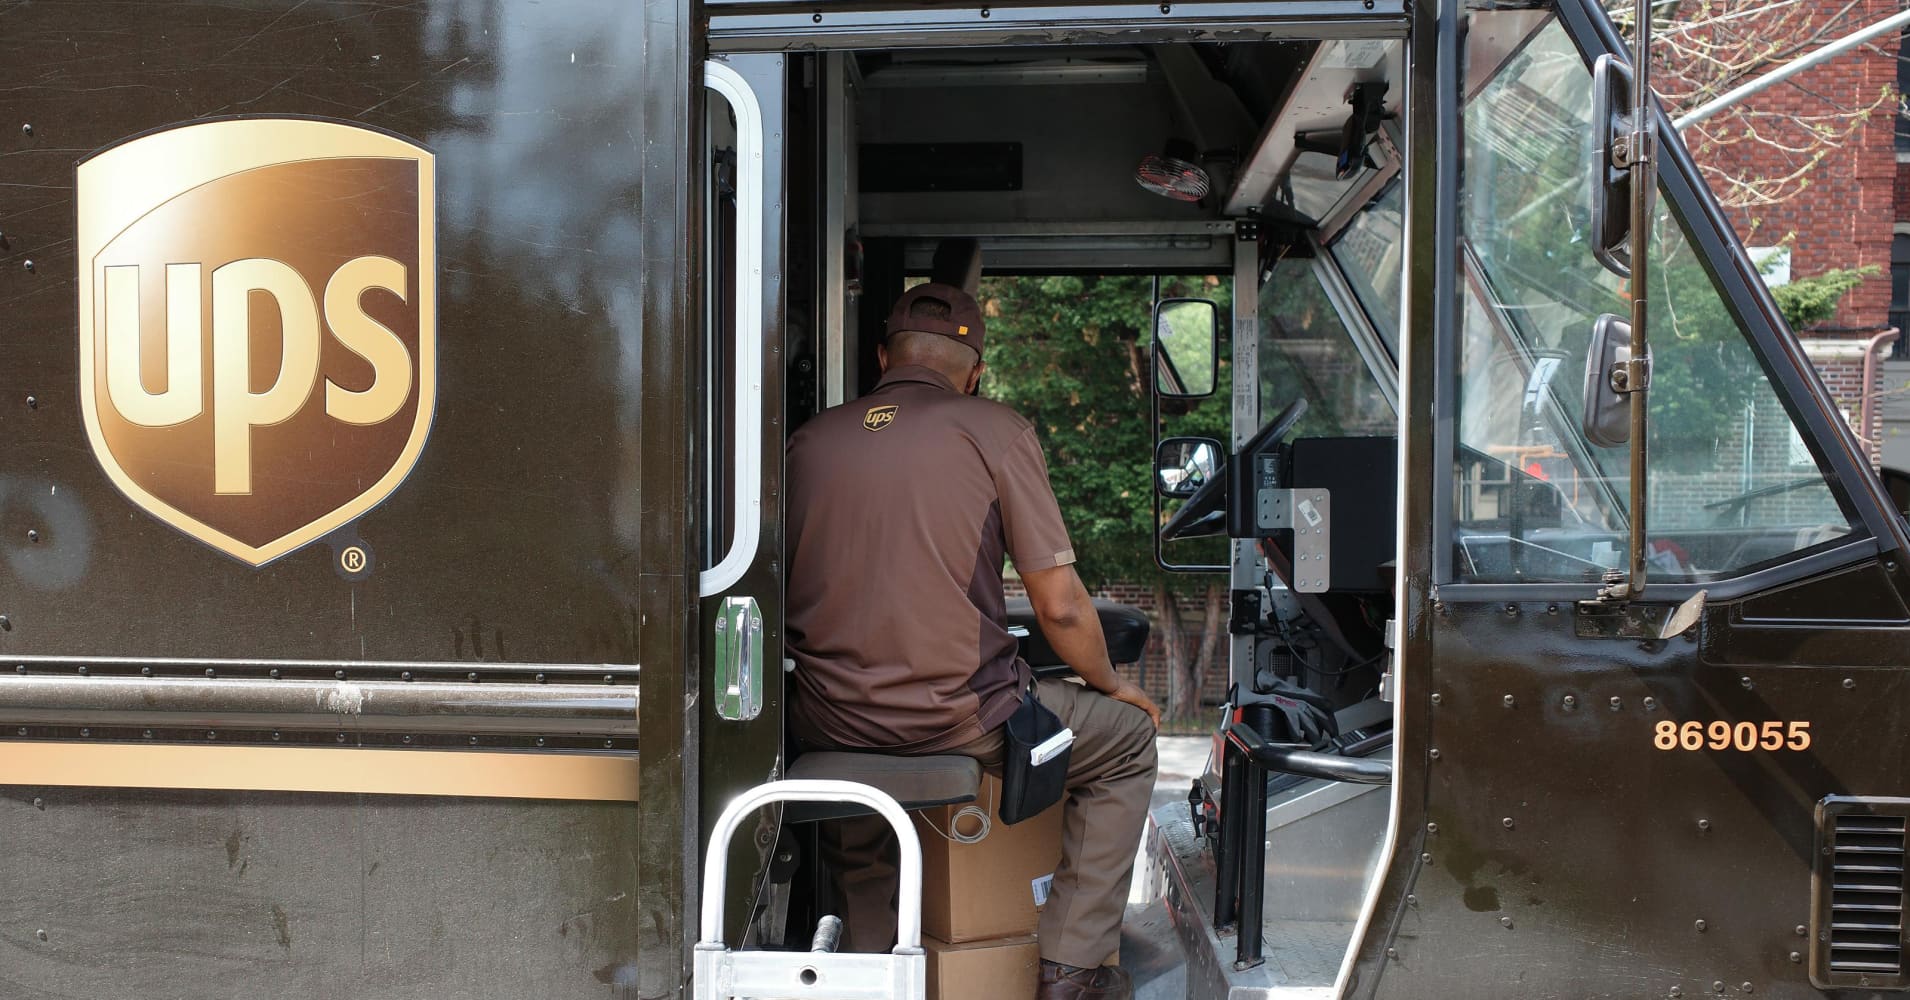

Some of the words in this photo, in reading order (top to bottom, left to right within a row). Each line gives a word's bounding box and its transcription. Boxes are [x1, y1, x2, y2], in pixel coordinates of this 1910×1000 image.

[104, 255, 413, 495] ups
[866, 411, 894, 426] ups
[1654, 720, 1811, 751] 869055
